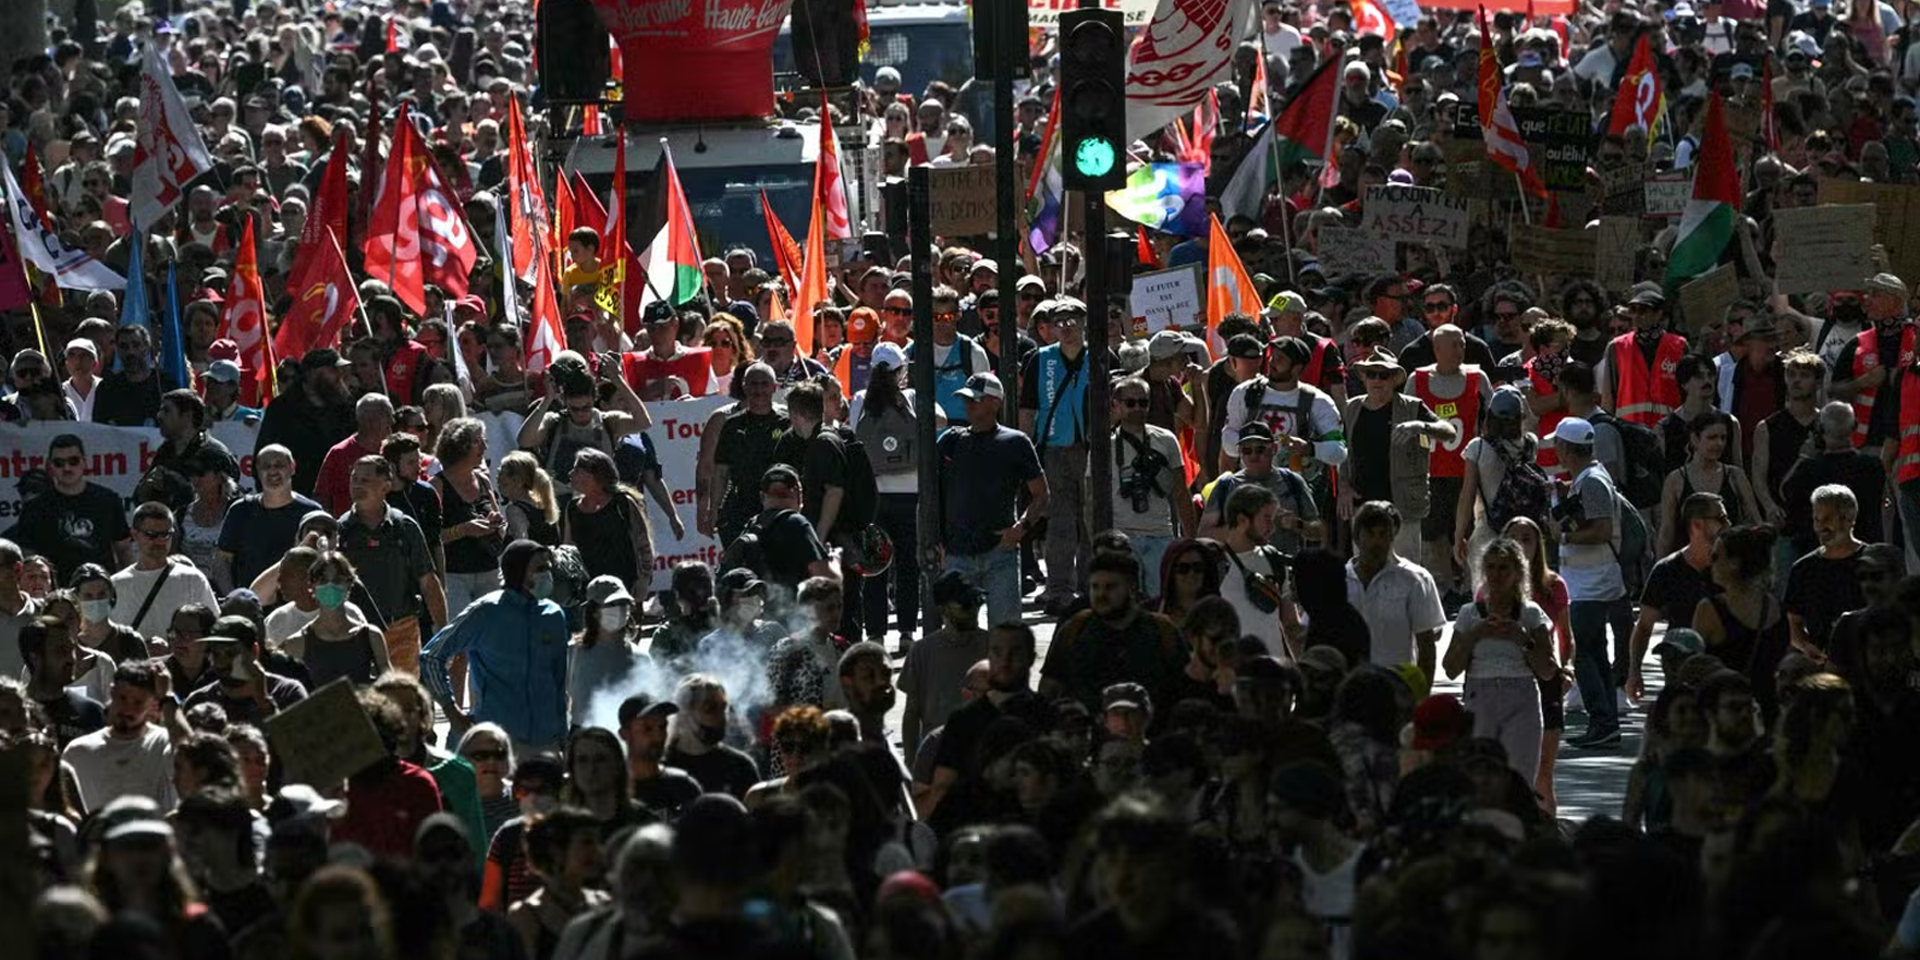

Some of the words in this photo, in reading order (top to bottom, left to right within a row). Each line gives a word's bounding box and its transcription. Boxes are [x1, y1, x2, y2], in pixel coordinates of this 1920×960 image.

[1521, 120, 1545, 134] que
[1547, 149, 1561, 160] ou
[1410, 204, 1424, 217] A
